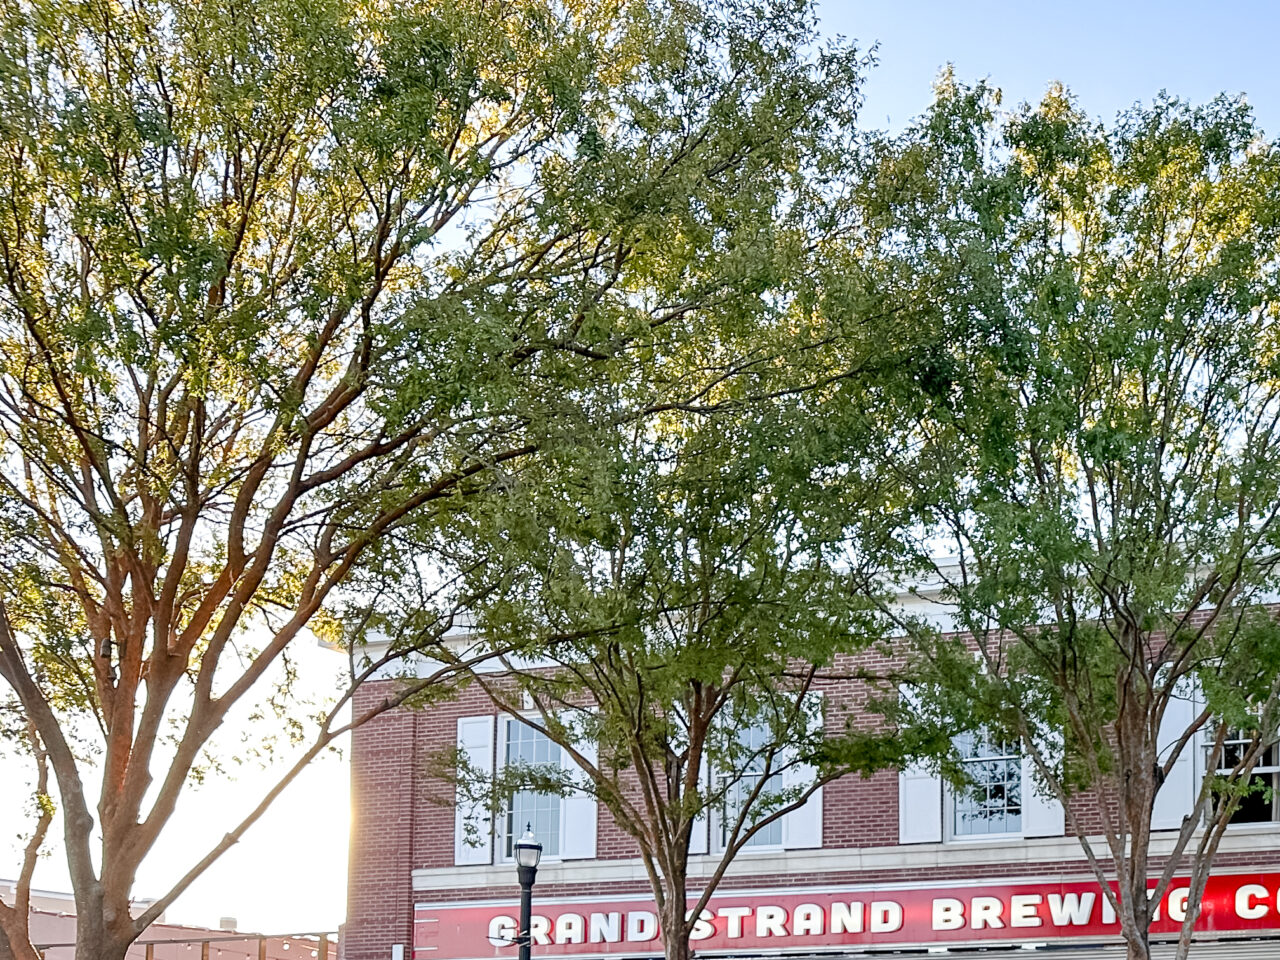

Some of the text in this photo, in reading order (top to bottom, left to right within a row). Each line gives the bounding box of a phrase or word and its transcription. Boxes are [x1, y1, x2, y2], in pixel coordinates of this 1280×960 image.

[488, 911, 660, 947] GRAND
[685, 901, 902, 940] STRAND
[932, 886, 1202, 930] BREWIG
